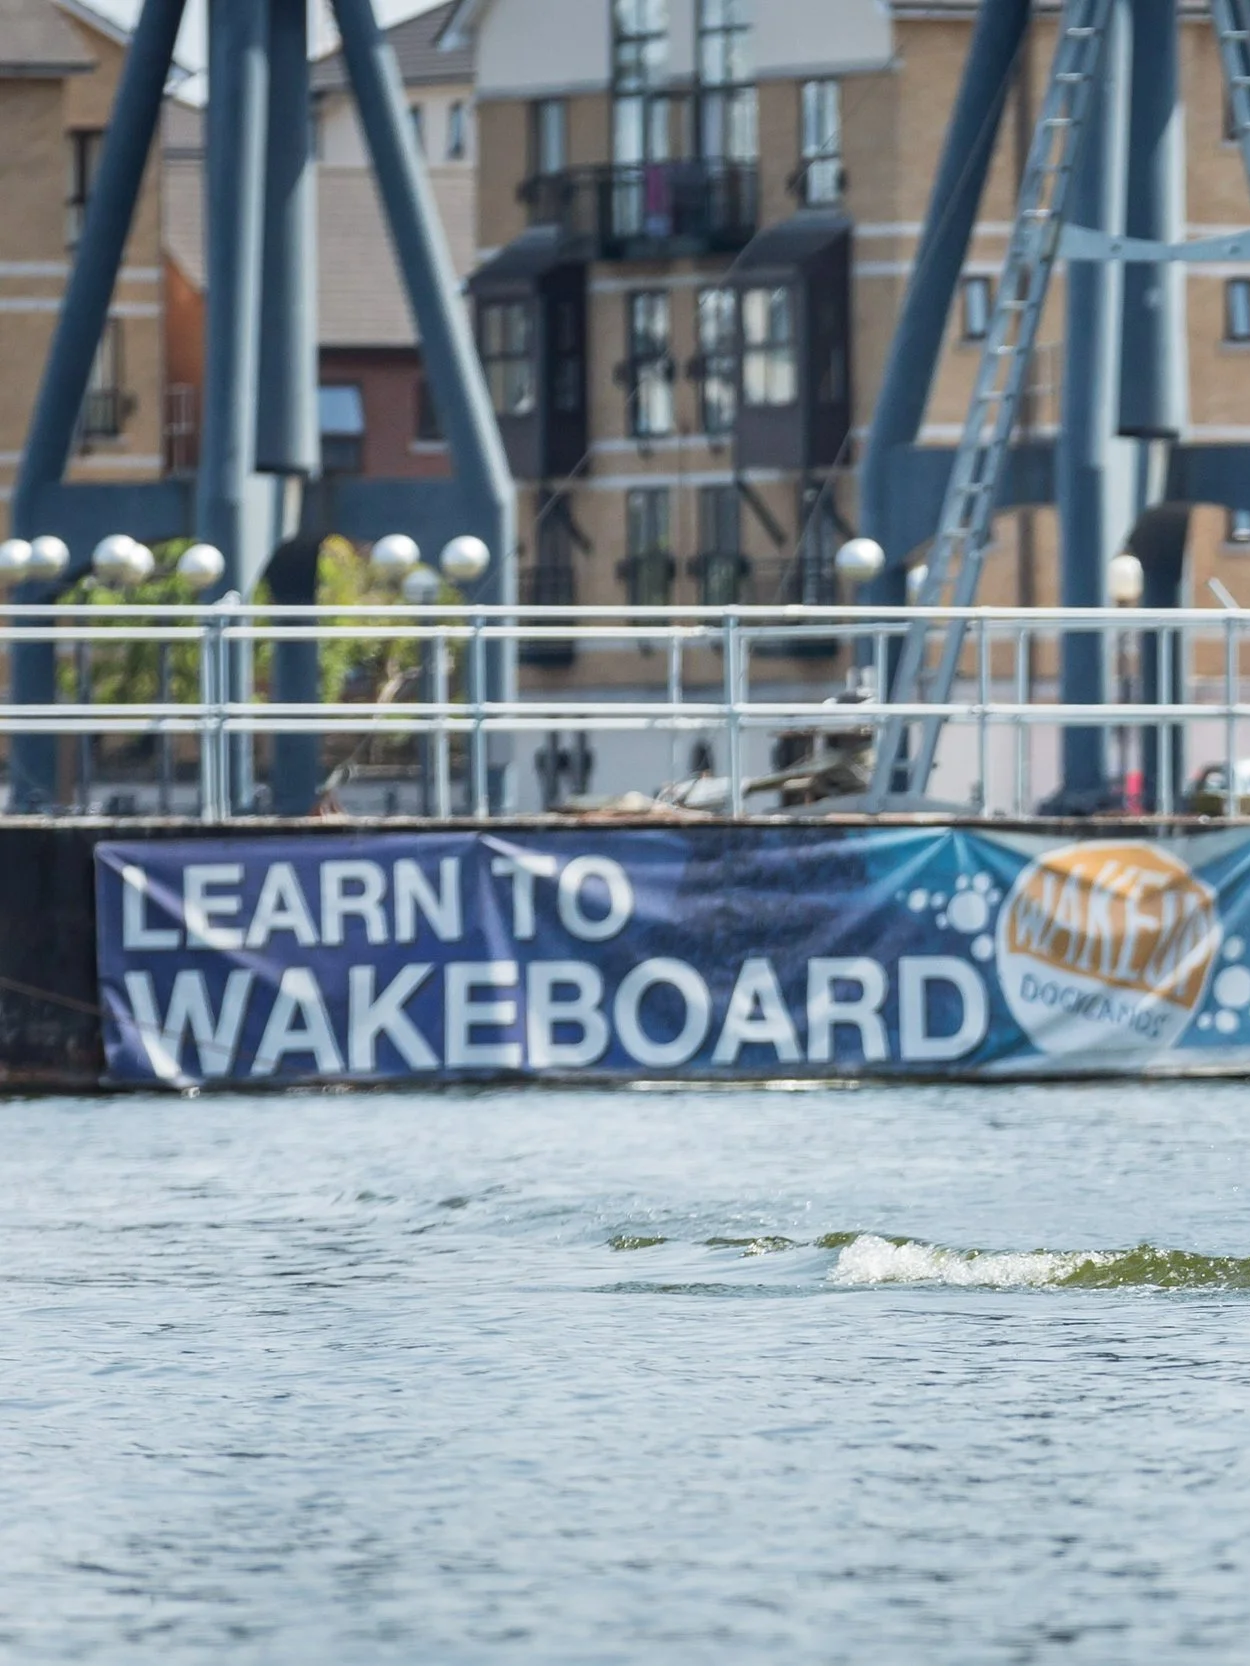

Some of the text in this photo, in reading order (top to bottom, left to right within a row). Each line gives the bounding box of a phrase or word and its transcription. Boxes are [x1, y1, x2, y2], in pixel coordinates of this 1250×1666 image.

[122, 854, 634, 950] LEARN TO
[124, 956, 989, 1078] WAKEBOARD
